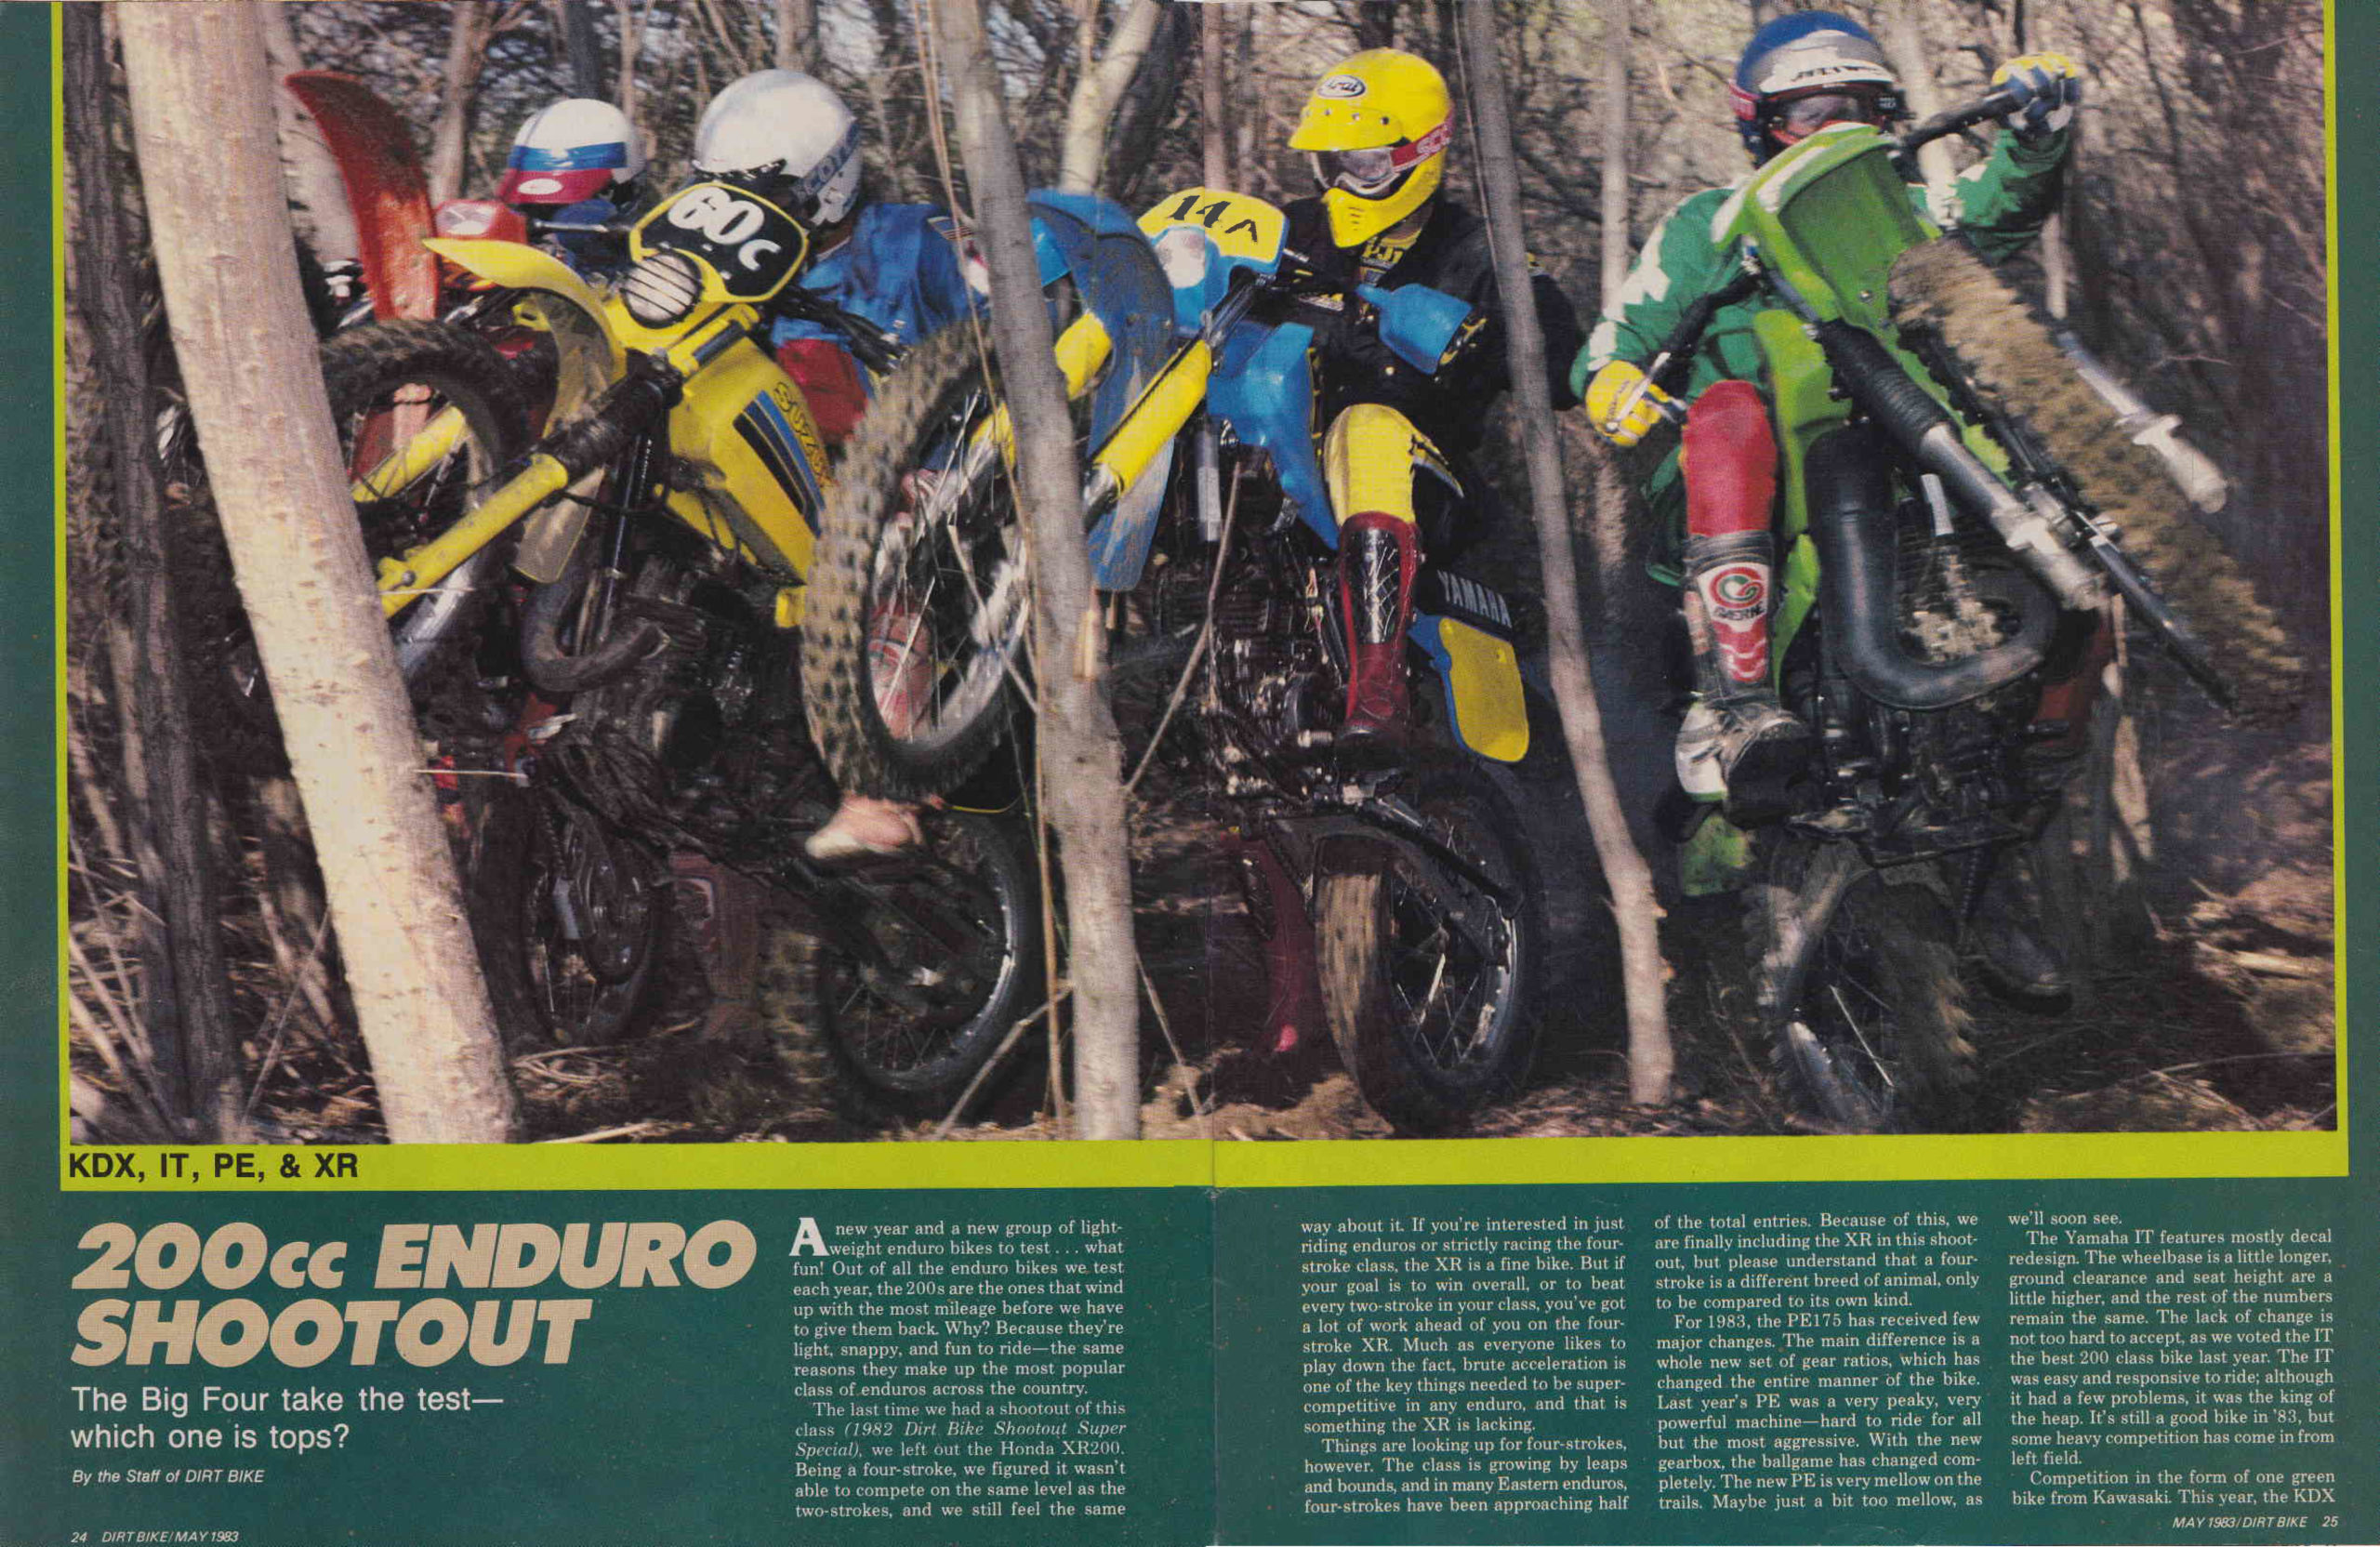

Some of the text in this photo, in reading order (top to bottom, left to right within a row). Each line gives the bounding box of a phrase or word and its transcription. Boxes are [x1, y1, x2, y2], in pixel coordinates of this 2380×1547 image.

[1437, 569, 1514, 629] YAMAHA
[69, 1152, 358, 1183] KDX, IT, PE, & XR
[1300, 1215, 1625, 1236] way about it. If you're interested in just
[1654, 1210, 1978, 1230] of the total entries. Because of this, we
[2007, 1210, 2122, 1226] we'll soon see.
[788, 1216, 1122, 1257] A new year and a new group of light-
[2026, 1227, 2332, 1247] The Yamaha IT features mostly decal
[71, 1219, 758, 1290] 200cc ENDURO
[1655, 1250, 1978, 1273] out, but please understand that a four-
[2009, 1267, 2333, 1289] ground clearance and seat height are a
[793, 1298, 1125, 1320] up with the most mileage before we have
[70, 1297, 594, 1368] SHOOTOUT
[1656, 1330, 1980, 1353] major changes. The main difference is a
[1302, 1334, 1626, 1355] stroke XR. Much as everyone likes to
[793, 1359, 1126, 1380] reasons they make up the most popular
[70, 1385, 128, 1412] The
[141, 1385, 189, 1419] Big
[203, 1385, 271, 1412] Four
[281, 1385, 345, 1412] take
[358, 1385, 405, 1412] the
[1302, 1395, 1627, 1417] competitive in any enduro, and that is
[70, 1422, 350, 1456] which one is tops?
[795, 1420, 1127, 1438] class (1982 Dirt Bike Shootout Super
[1304, 1454, 1628, 1474] however. The class is growing by leaps
[1658, 1450, 1981, 1474] gearbox, the ballgame has changed com-
[72, 1468, 266, 1487] By the Staff of DIRT BIKE
[2030, 1468, 2335, 1488] Competition in the form of one green
[2171, 1515, 2206, 1529] MAY
[2277, 1515, 2309, 1528] BIKE
[2320, 1514, 2341, 1528] 25
[70, 1530, 88, 1544] 24
[100, 1530, 136, 1544] DIRT
[210, 1530, 241, 1543] 1983
